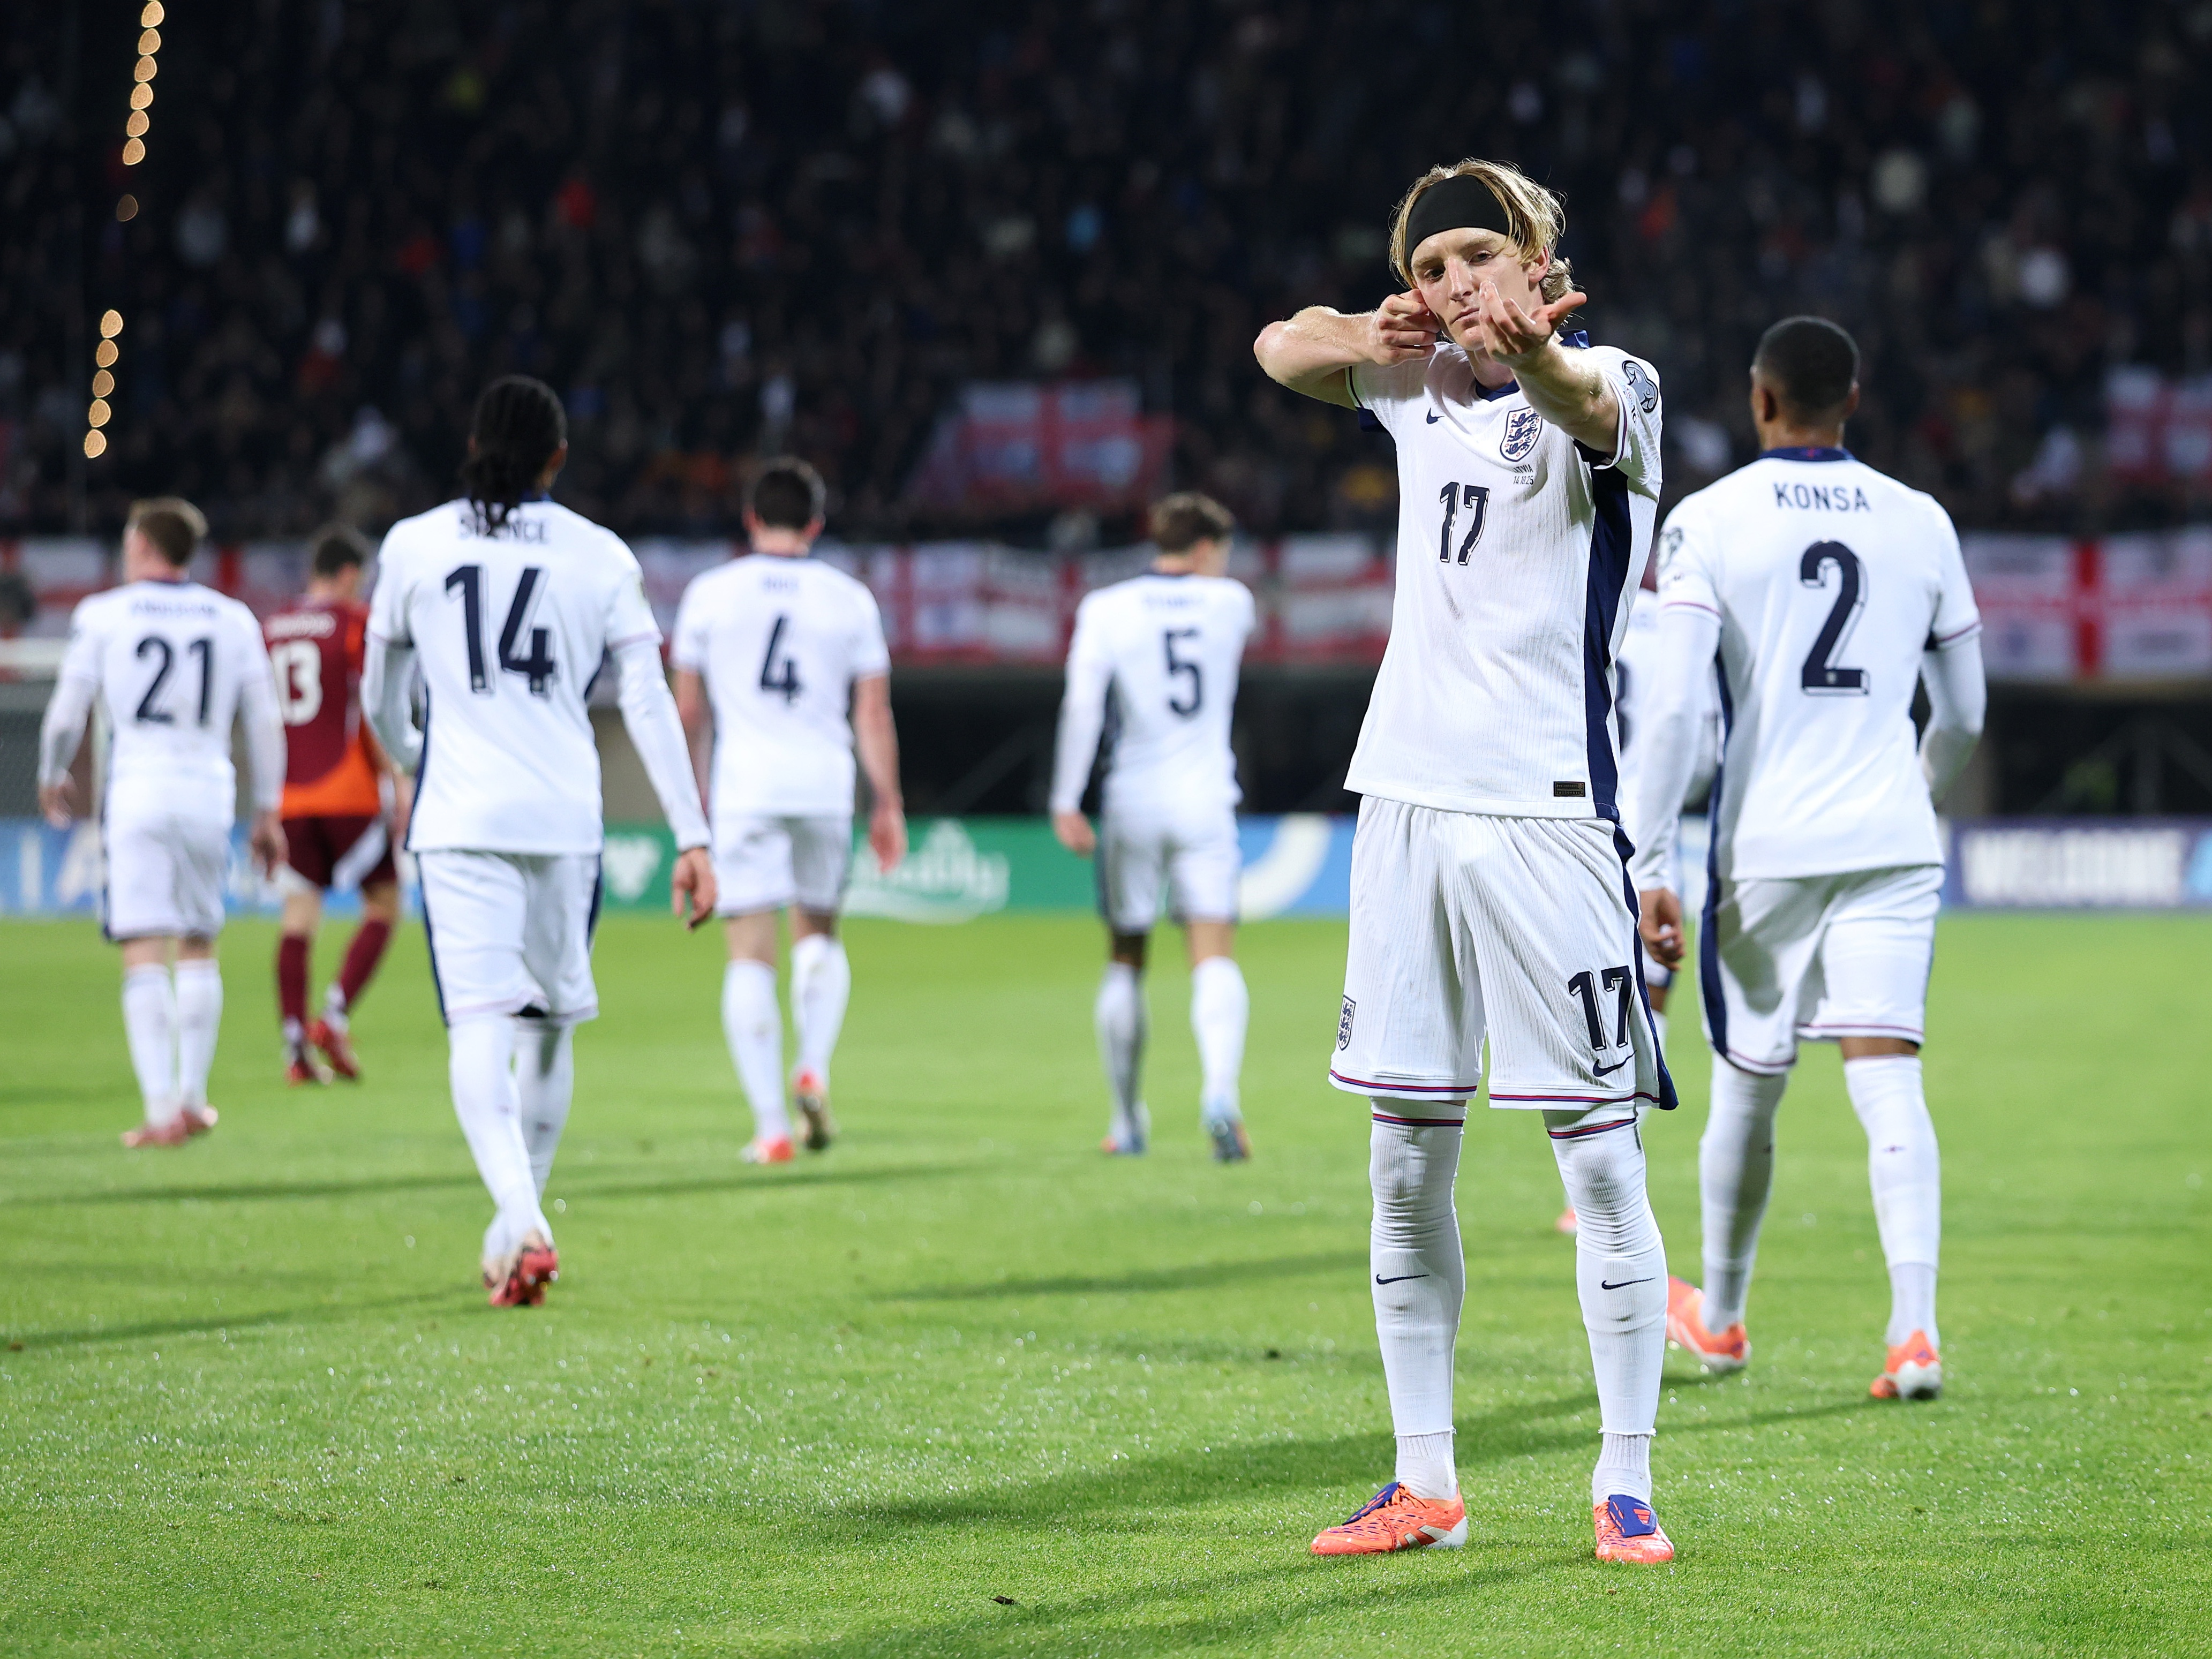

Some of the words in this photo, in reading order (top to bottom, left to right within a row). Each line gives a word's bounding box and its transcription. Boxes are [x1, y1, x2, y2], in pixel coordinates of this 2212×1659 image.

[1440, 481, 1490, 565] 17
[1513, 476, 1534, 485] 14.10.25
[1773, 482, 1871, 511] KONSA
[446, 565, 560, 699] 14
[759, 616, 804, 703] 4
[1800, 540, 1870, 697] 2
[136, 635, 213, 725] 21
[1164, 628, 1203, 718] 5
[1568, 966, 1635, 1051] 17
